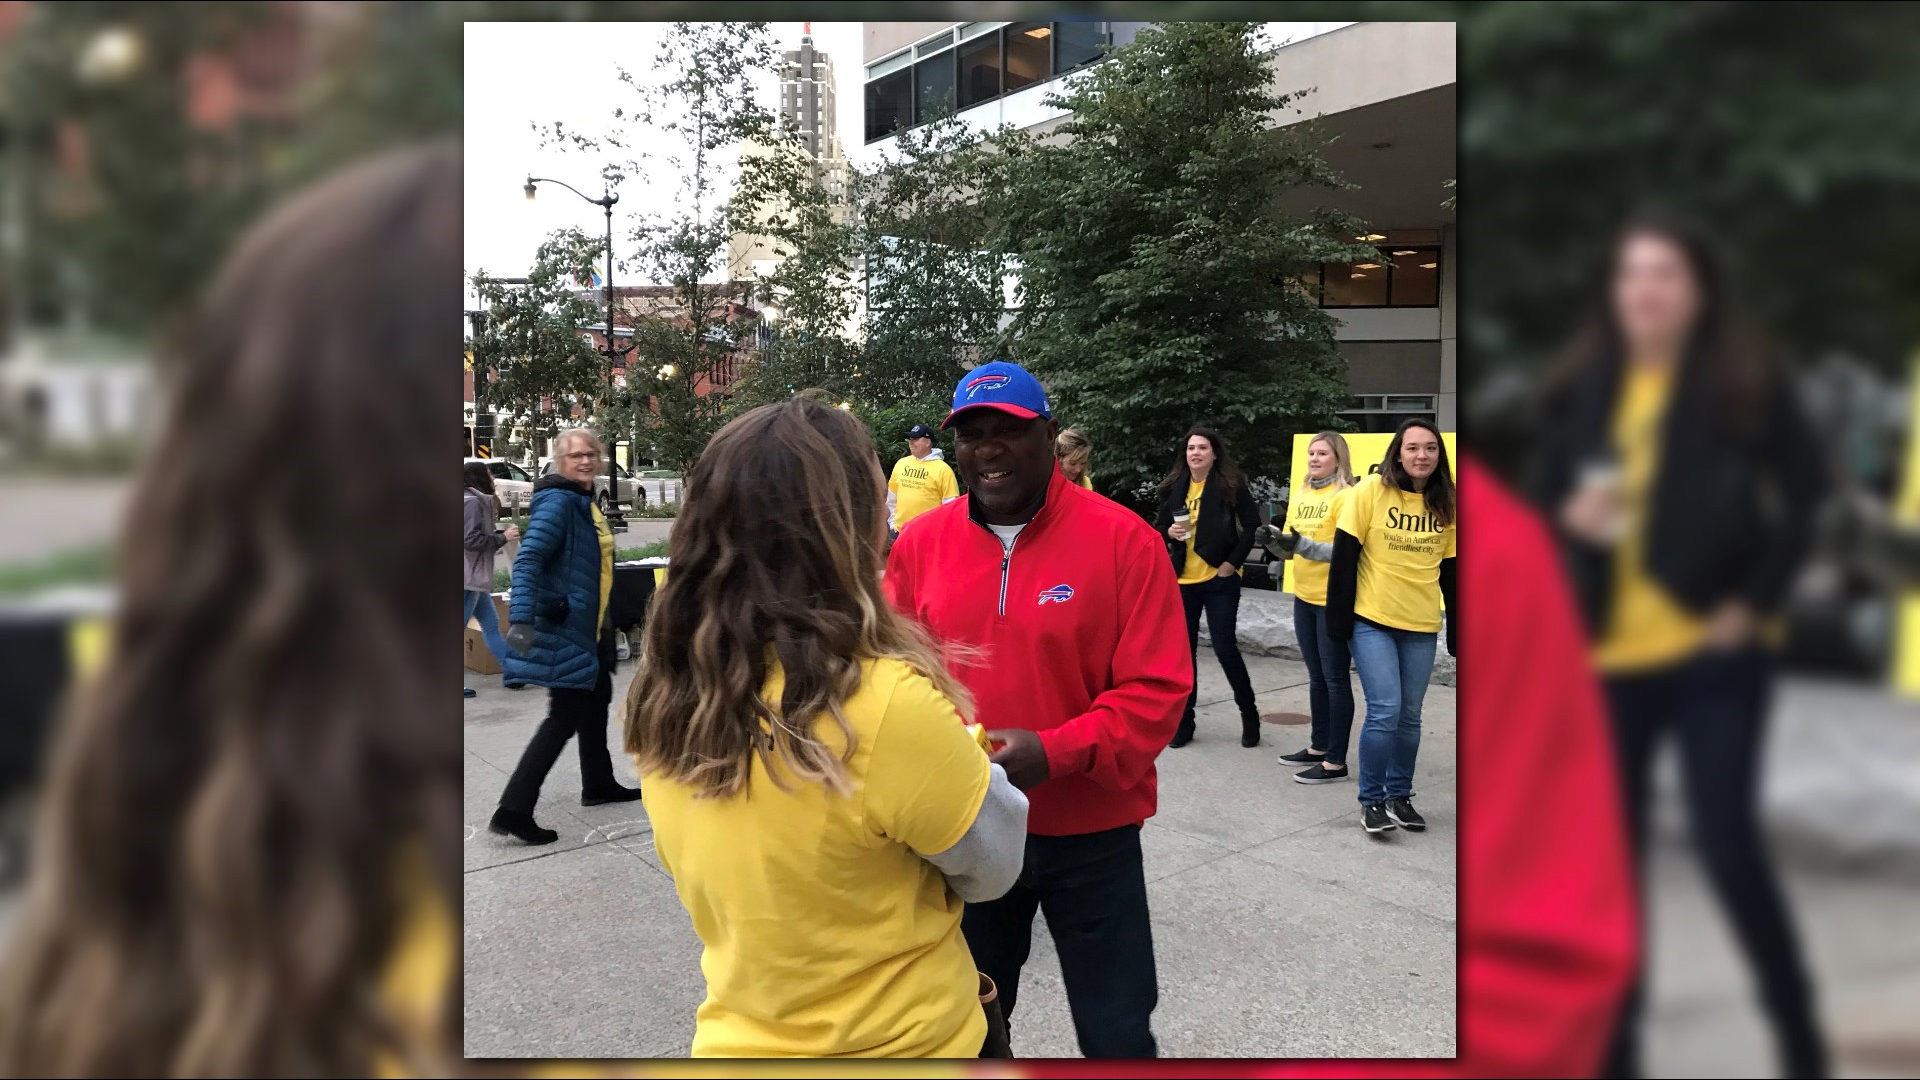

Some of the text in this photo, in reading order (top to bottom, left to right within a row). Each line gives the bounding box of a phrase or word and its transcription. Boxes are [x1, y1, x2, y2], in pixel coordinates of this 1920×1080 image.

[902, 466, 929, 480] Smile
[1295, 501, 1328, 519] Smile
[1386, 506, 1444, 533] Smile
[1404, 535, 1412, 543] in
[1388, 542, 1421, 553] friendliest
